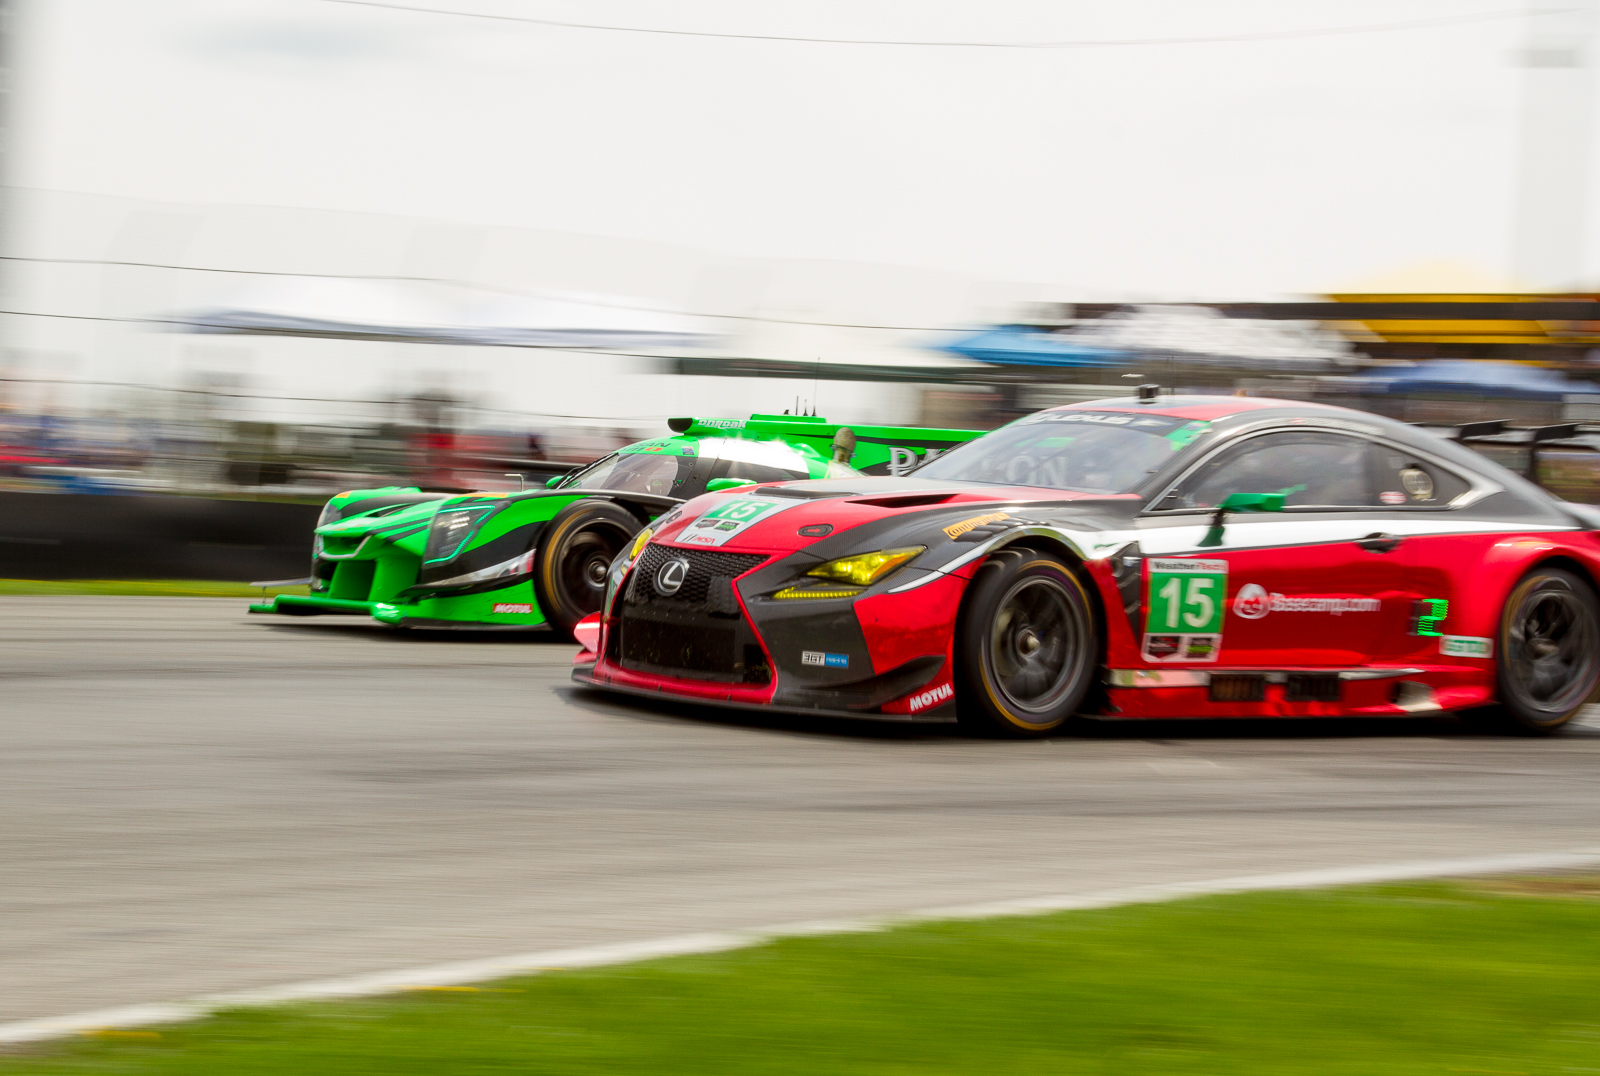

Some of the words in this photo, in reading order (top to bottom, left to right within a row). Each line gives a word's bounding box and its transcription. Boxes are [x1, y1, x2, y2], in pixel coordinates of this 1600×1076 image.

[1048, 414, 1135, 425] LEXUS
[718, 501, 769, 519] 15
[1159, 577, 1216, 628] 15
[1417, 598, 1449, 637] 2
[909, 682, 954, 712] MOTUL
